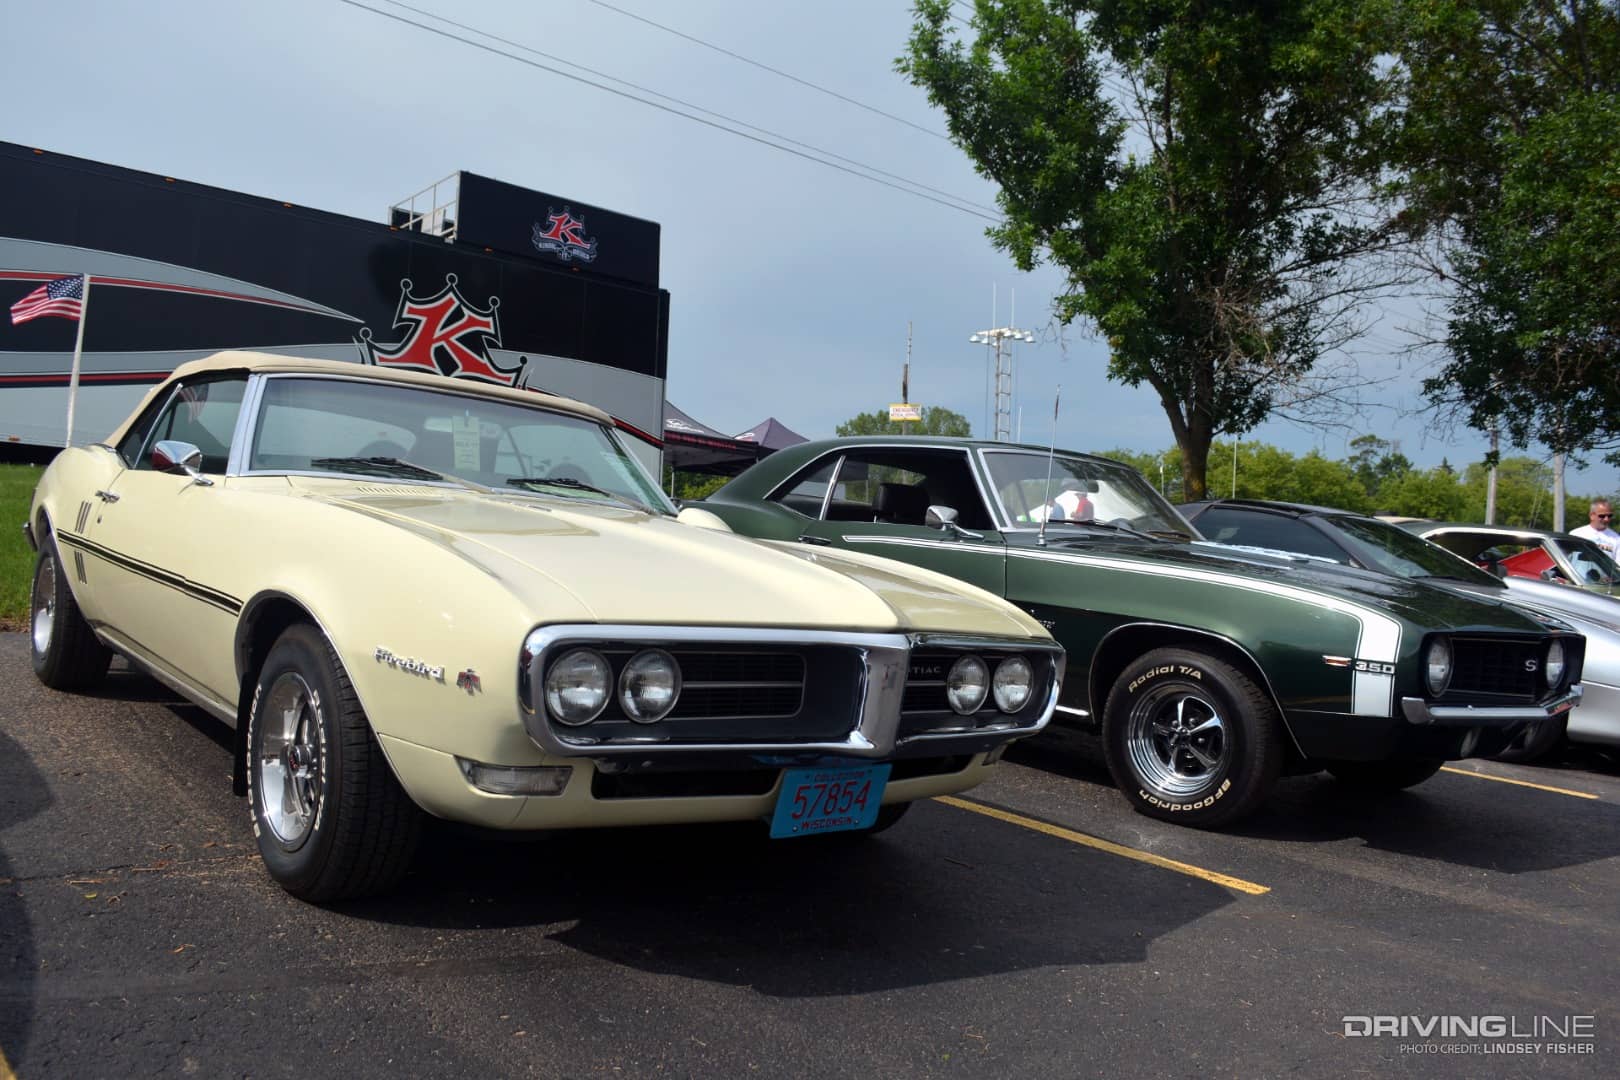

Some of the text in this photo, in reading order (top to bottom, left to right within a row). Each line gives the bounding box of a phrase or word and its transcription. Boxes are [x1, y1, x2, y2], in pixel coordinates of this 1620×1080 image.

[374, 645, 446, 681] Firebird
[1128, 665, 1203, 693] Radial T/A
[1355, 661, 1396, 674] 350
[791, 779, 872, 820] 57854
[1138, 778, 1232, 812] BFGoodrich
